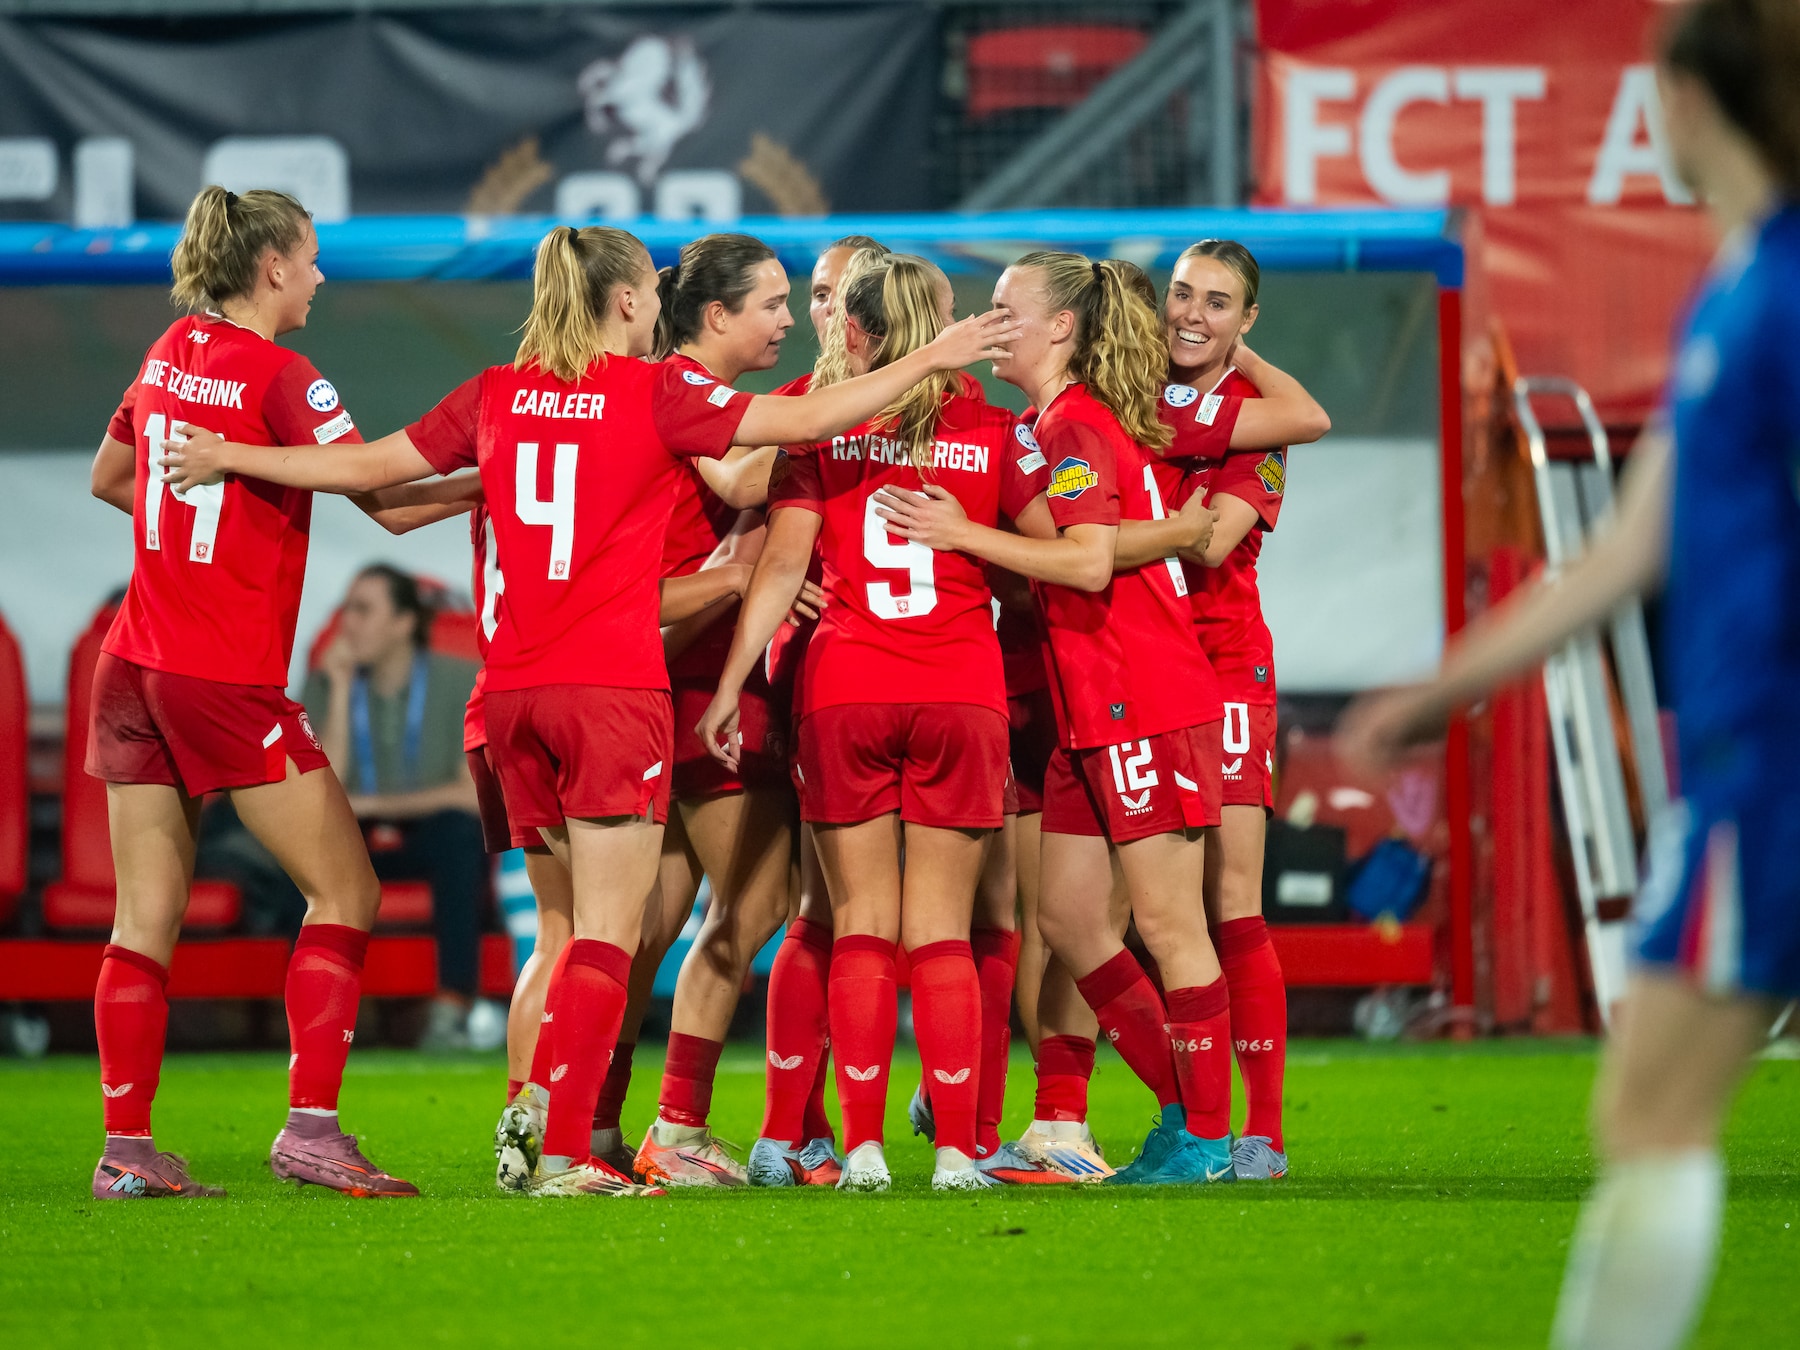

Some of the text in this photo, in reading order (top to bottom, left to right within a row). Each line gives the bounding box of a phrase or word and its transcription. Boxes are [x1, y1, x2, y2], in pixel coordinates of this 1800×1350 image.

[1284, 66, 1547, 207] FCT
[511, 389, 605, 420] CARLEER
[832, 434, 989, 474] RAVENSRGEN
[1055, 466, 1083, 483] EURO
[515, 442, 579, 580] 4
[1108, 738, 1159, 794] 12
[1171, 1036, 1213, 1052] 1965
[1235, 1039, 1274, 1051] 1965
